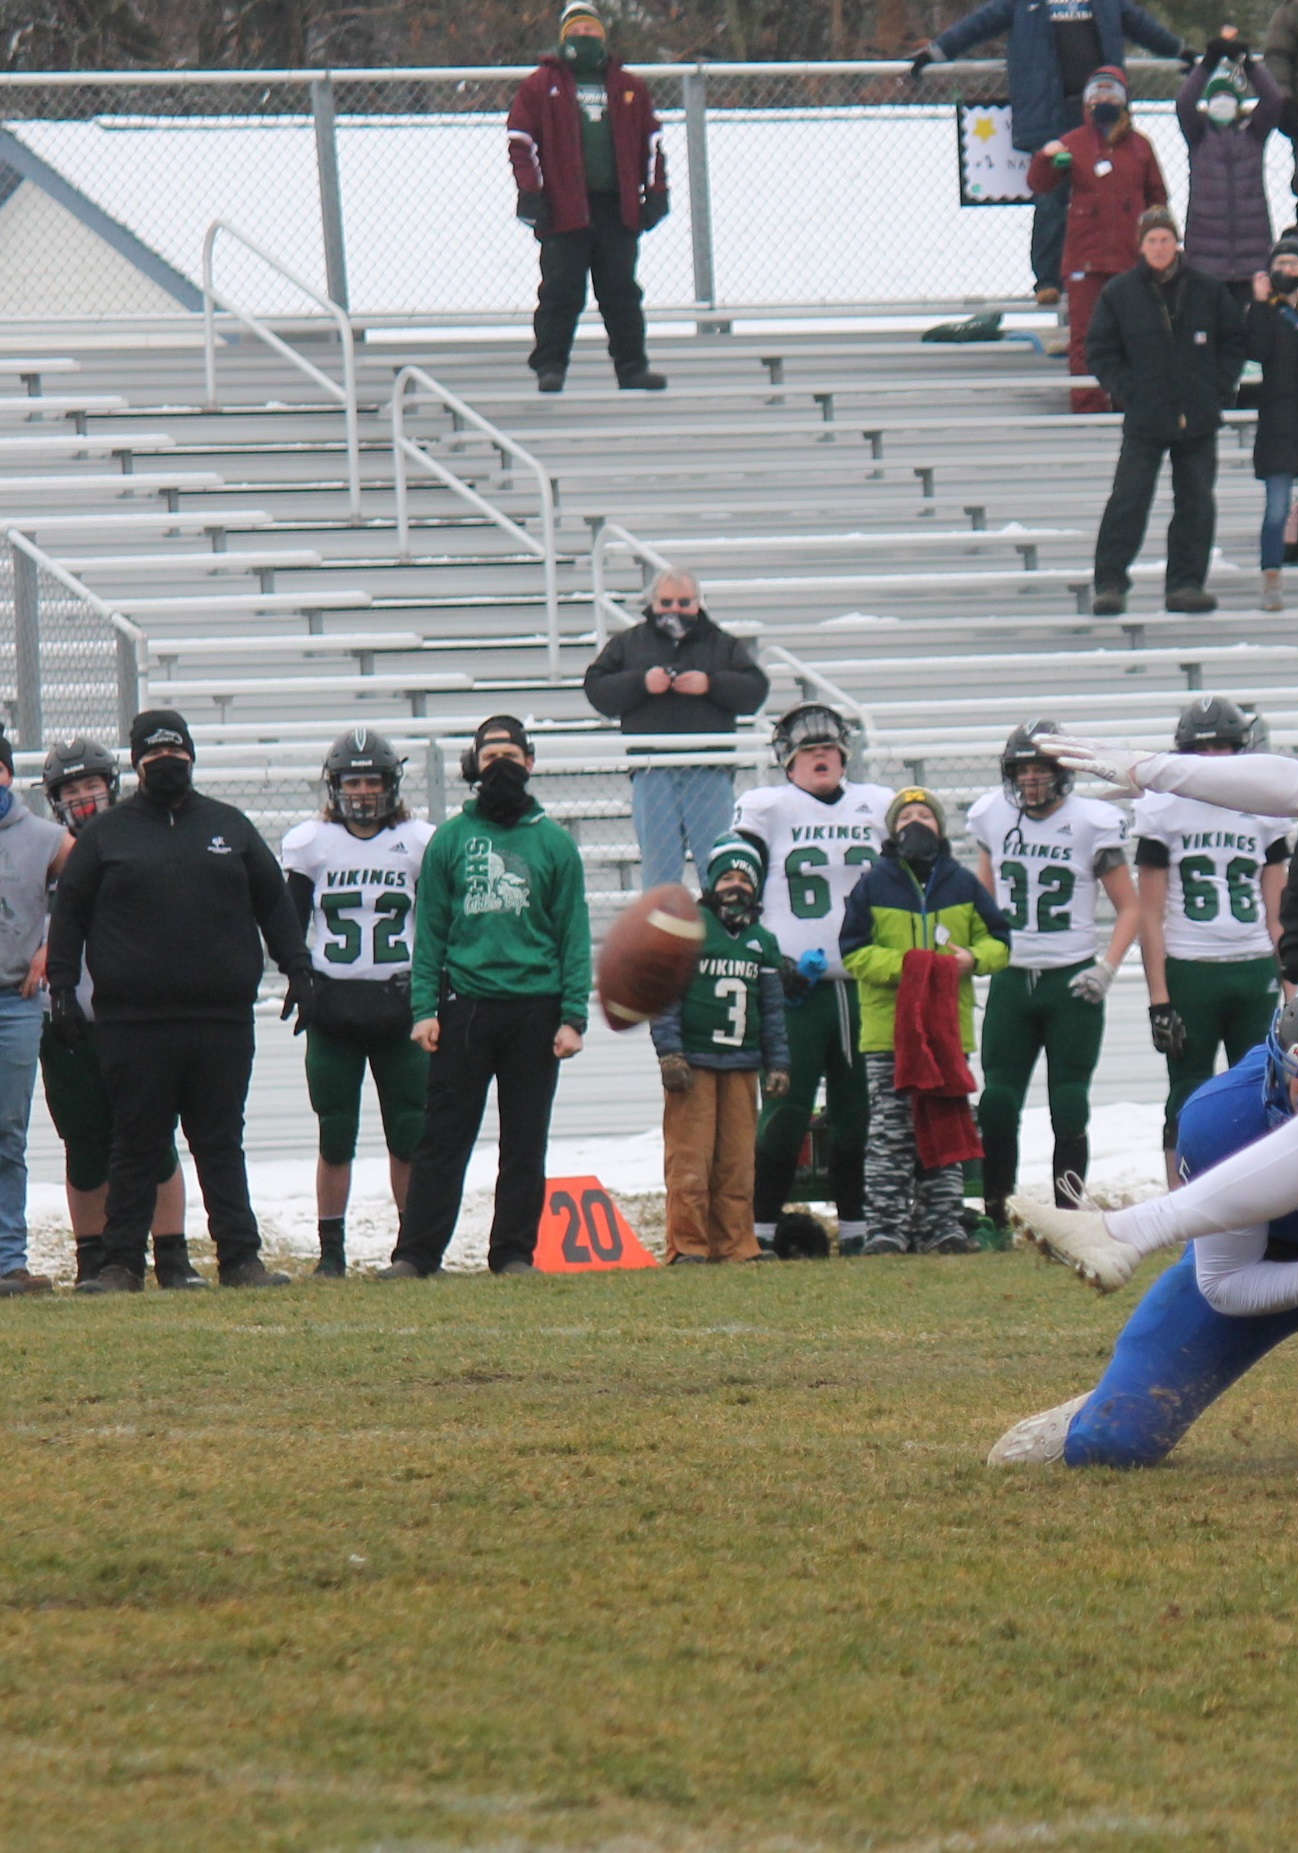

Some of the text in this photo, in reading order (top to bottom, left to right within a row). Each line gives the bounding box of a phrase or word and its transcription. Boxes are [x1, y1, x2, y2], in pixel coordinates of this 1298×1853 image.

[904, 790, 926, 802] M
[791, 825, 873, 842] VIKINGS
[1181, 832, 1258, 852] VIKINGS
[1003, 841, 1073, 861] VIKINGS
[327, 868, 407, 888] VIKINGS
[1179, 855, 1260, 923] 66
[1000, 860, 1076, 932] 32
[320, 891, 413, 964] 52
[698, 958, 760, 980] VIKINGS
[711, 977, 748, 1048] 3
[550, 1188, 624, 1263] 20
